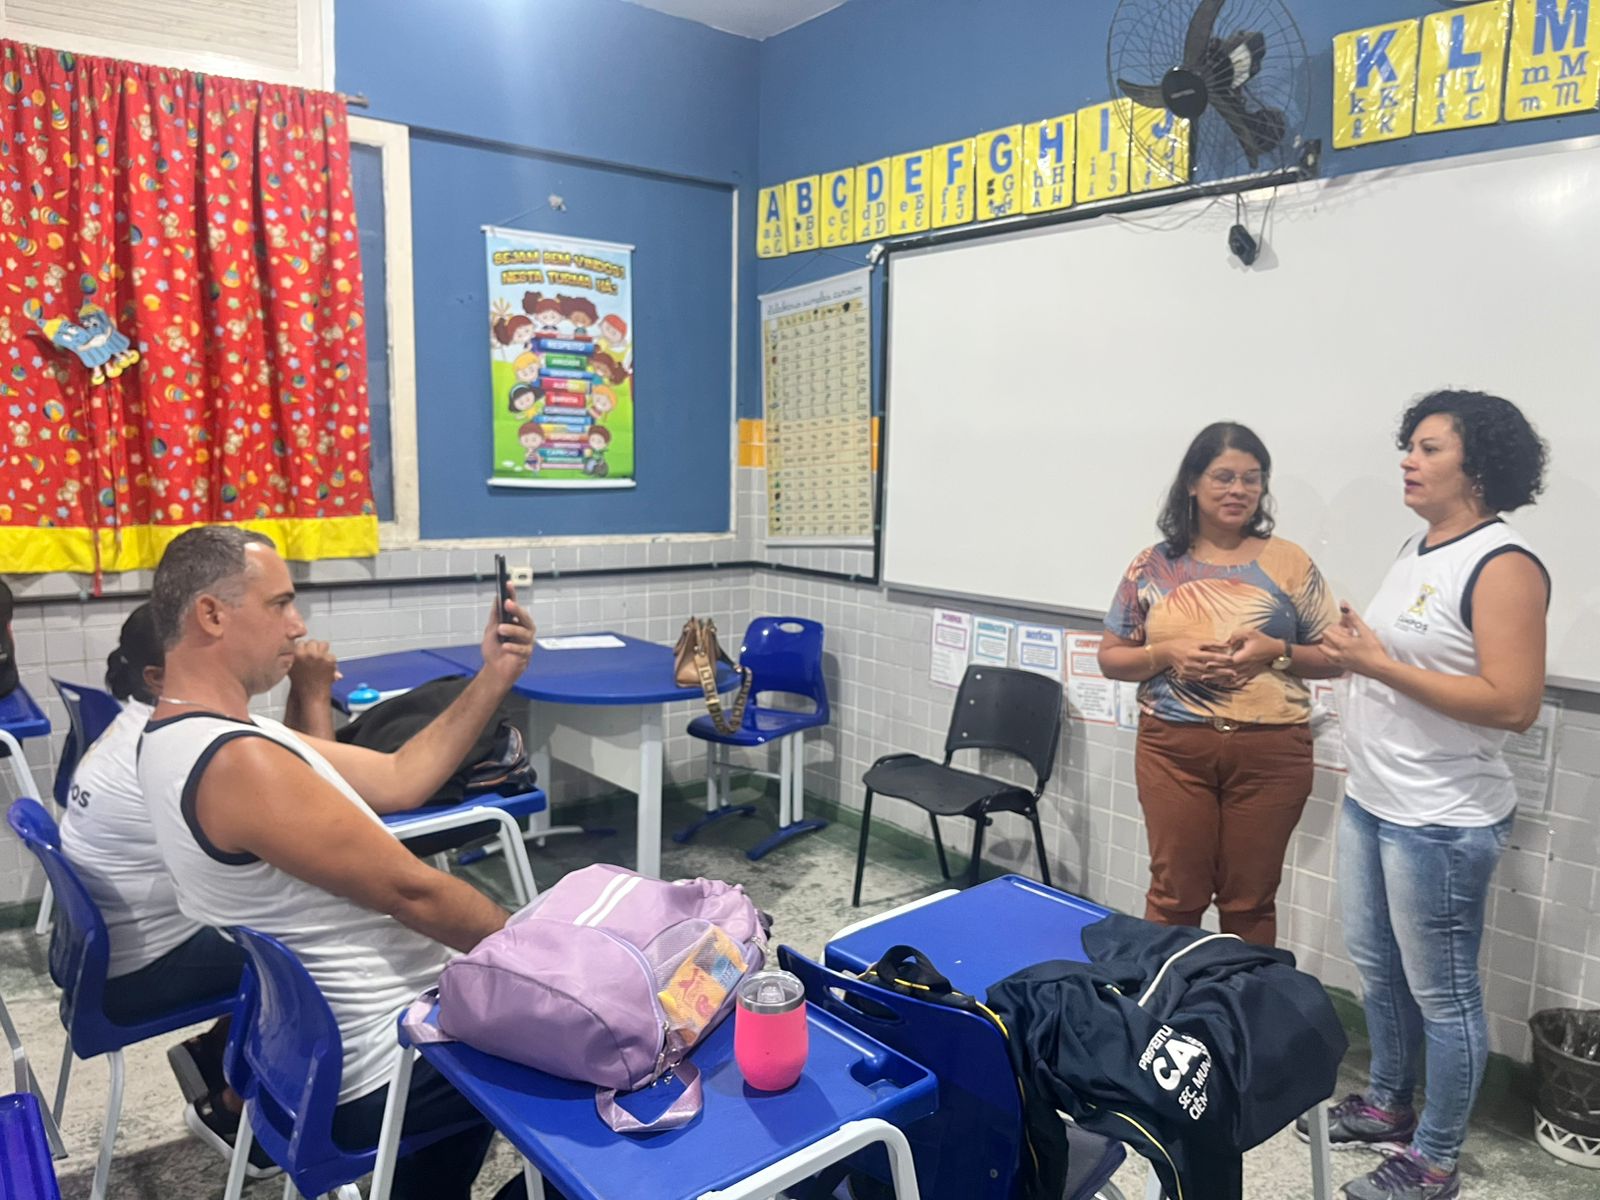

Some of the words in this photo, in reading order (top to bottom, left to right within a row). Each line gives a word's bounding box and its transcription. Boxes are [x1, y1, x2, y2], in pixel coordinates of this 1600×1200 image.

[1447, 15, 1482, 70] L
[1533, 0, 1589, 56] M
[1355, 29, 1397, 88] K
[1521, 66, 1549, 85] m
[1557, 52, 1589, 79] M
[1464, 71, 1485, 94] L
[1349, 92, 1365, 115] k
[1379, 85, 1400, 109] K
[1100, 108, 1109, 152] I
[1152, 107, 1173, 139] J
[989, 133, 1013, 173] G
[1039, 123, 1063, 163] H
[906, 156, 922, 193] E
[947, 145, 964, 185] F
[1034, 170, 1044, 188] h
[1052, 165, 1065, 183] H
[1090, 157, 1096, 175] i
[1109, 153, 1117, 171] I
[797, 182, 812, 215] B
[832, 175, 847, 208] C
[866, 166, 883, 202] D
[957, 185, 966, 201] F
[1003, 175, 1014, 192] G
[766, 191, 780, 222] A
[829, 216, 835, 227] c
[841, 209, 849, 224] C
[862, 205, 870, 220] d
[876, 202, 885, 218] D
[900, 200, 908, 212] e
[915, 194, 924, 209] E
[774, 224, 782, 238] A
[806, 216, 814, 231] B
[493, 250, 539, 266] SEJAM
[502, 270, 544, 284] NESTA
[547, 271, 592, 288] TURMA
